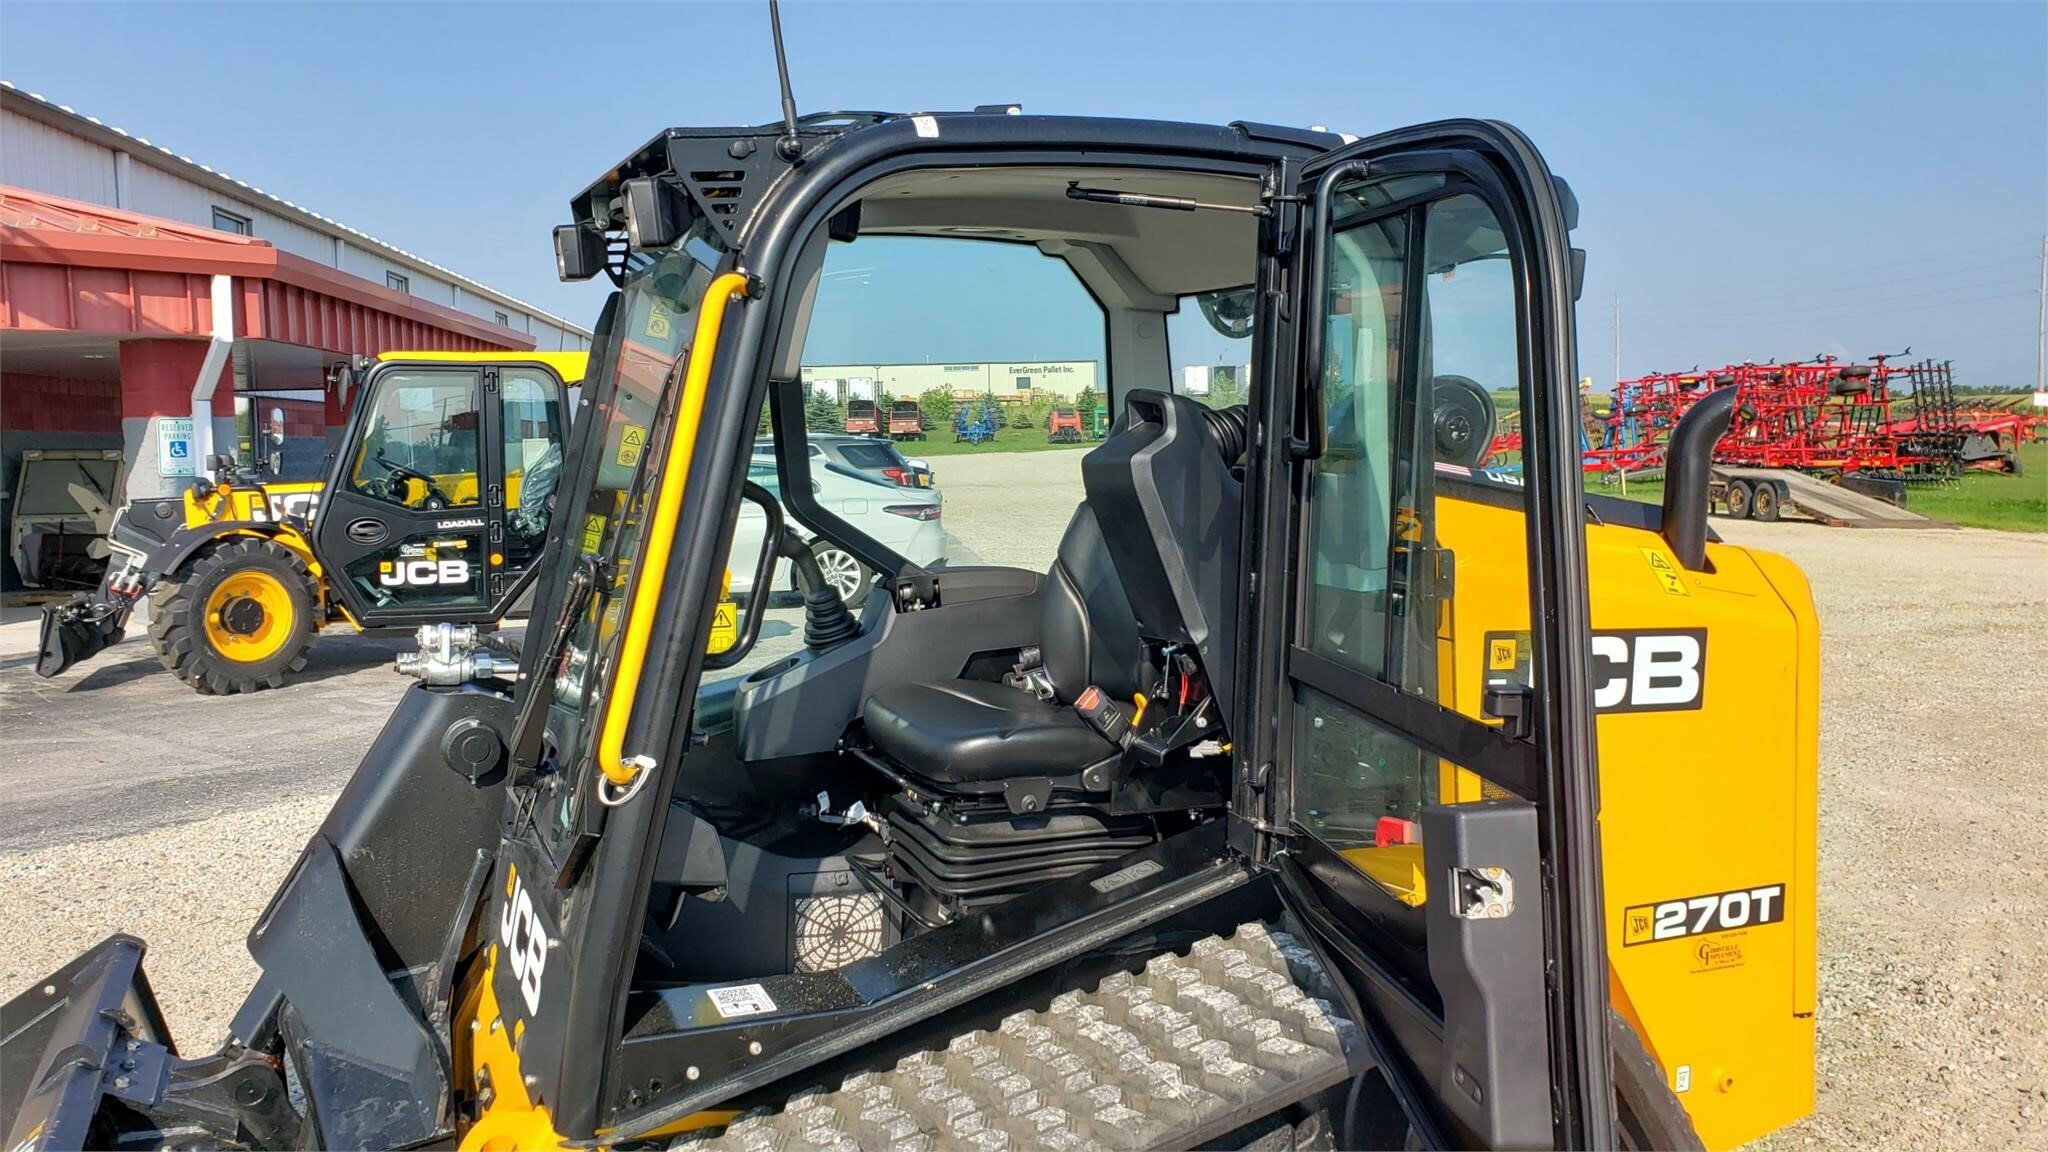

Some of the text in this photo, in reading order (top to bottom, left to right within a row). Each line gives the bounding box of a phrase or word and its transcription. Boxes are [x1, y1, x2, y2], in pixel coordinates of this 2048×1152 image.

[1009, 365, 1075, 374] EverGreen Pallet Inc.
[161, 423, 193, 431] RESERVED
[164, 432, 192, 440] PARKING
[437, 519, 485, 529] LOADALL
[380, 560, 469, 585] JCB
[1654, 886, 1781, 940] 270T
[501, 875, 547, 1016] JCB
